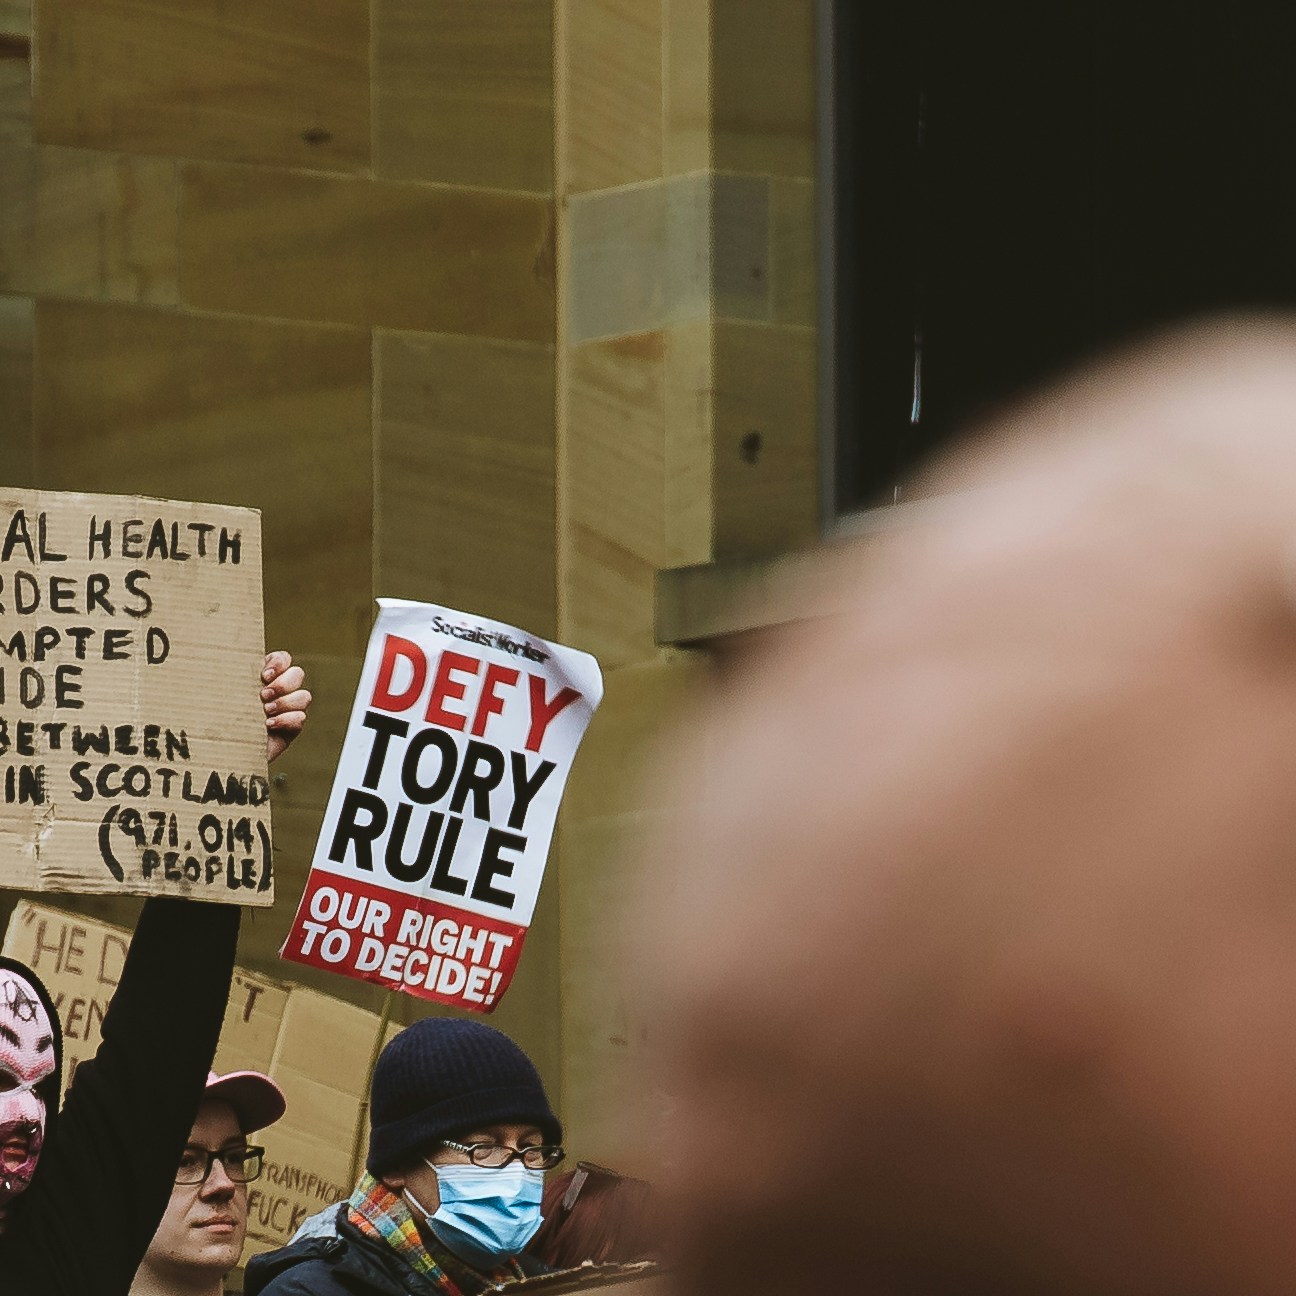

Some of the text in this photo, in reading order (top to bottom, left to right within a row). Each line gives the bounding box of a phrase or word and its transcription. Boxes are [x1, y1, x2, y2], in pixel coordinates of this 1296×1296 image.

[88, 518, 242, 566] HEALTH
[370, 633, 584, 753] DEFY
[5, 764, 46, 804] IN
[71, 762, 270, 807] SCOTLAND
[362, 710, 557, 832] TORY
[328, 787, 528, 910] RULE
[300, 921, 503, 1006] TO DECIDE!
[309, 887, 513, 969] OUR RIGHT
[246, 1190, 306, 1235] FUCK
